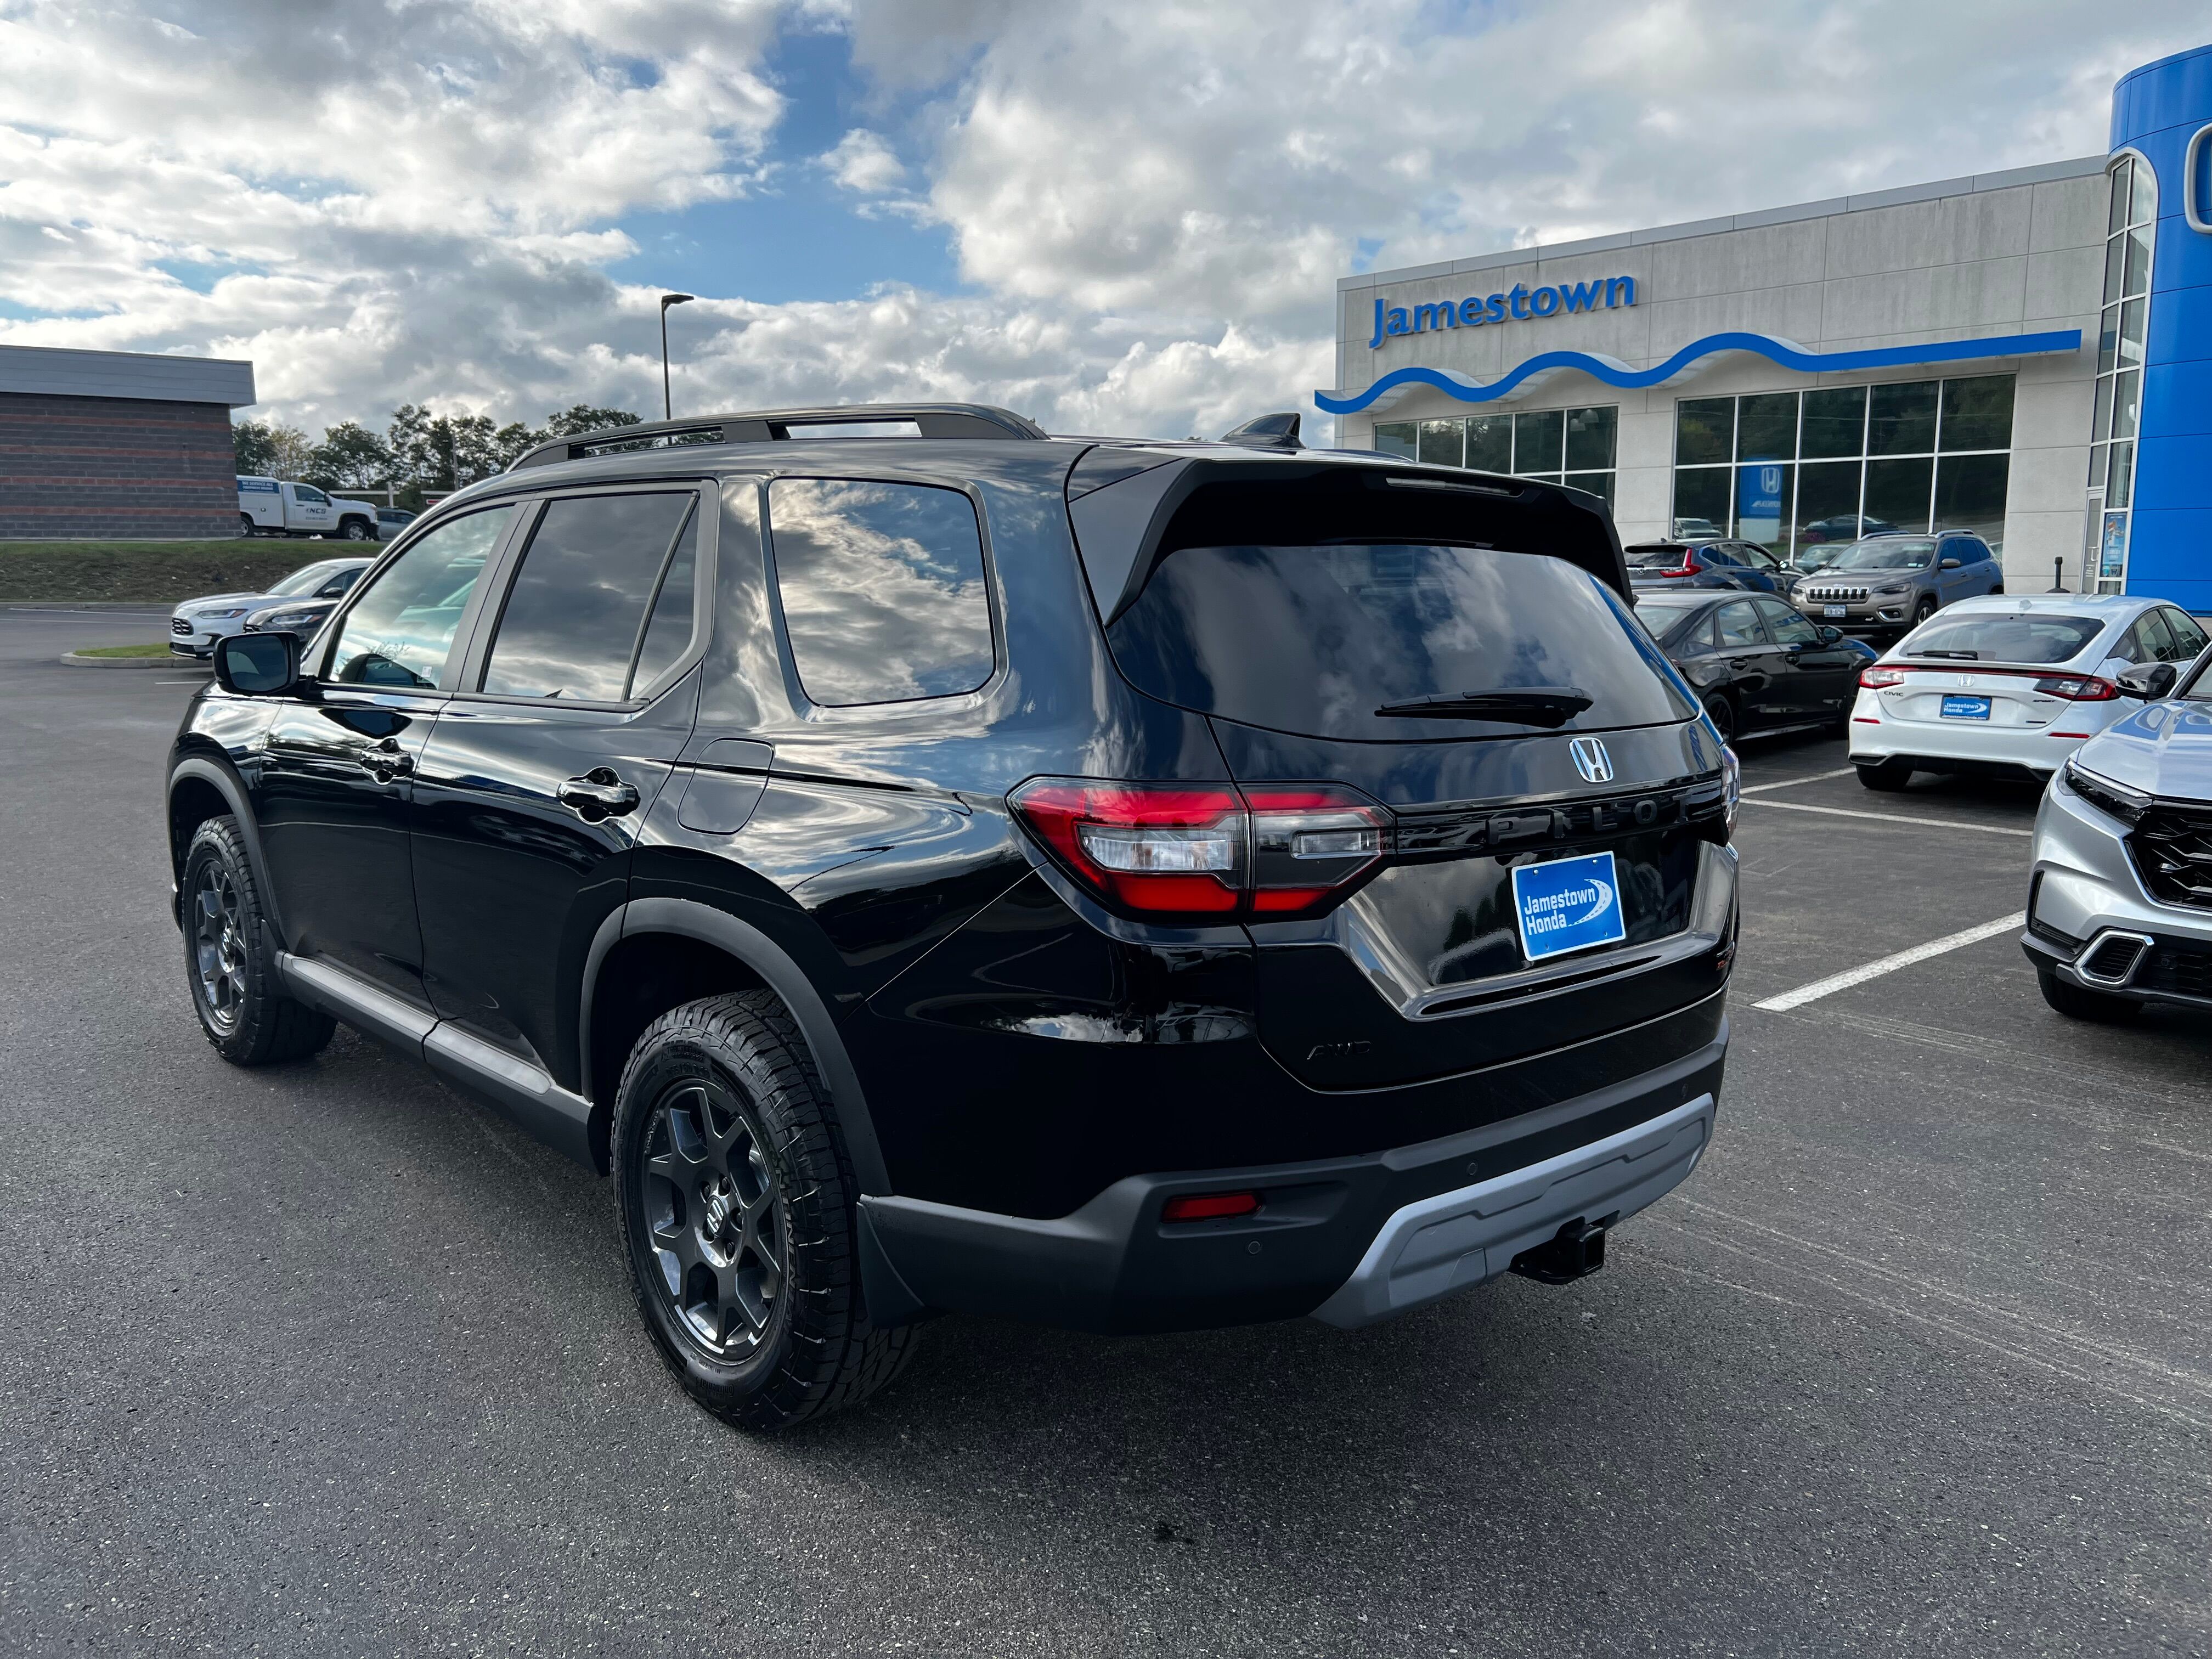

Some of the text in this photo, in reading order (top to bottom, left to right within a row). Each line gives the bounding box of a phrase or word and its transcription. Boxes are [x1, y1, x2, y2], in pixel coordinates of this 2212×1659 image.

[1369, 275, 1638, 349] Jamestown
[1488, 793, 1695, 845] PILOT
[1523, 887, 1596, 916] Jamestown
[1526, 910, 1567, 936] Honda
